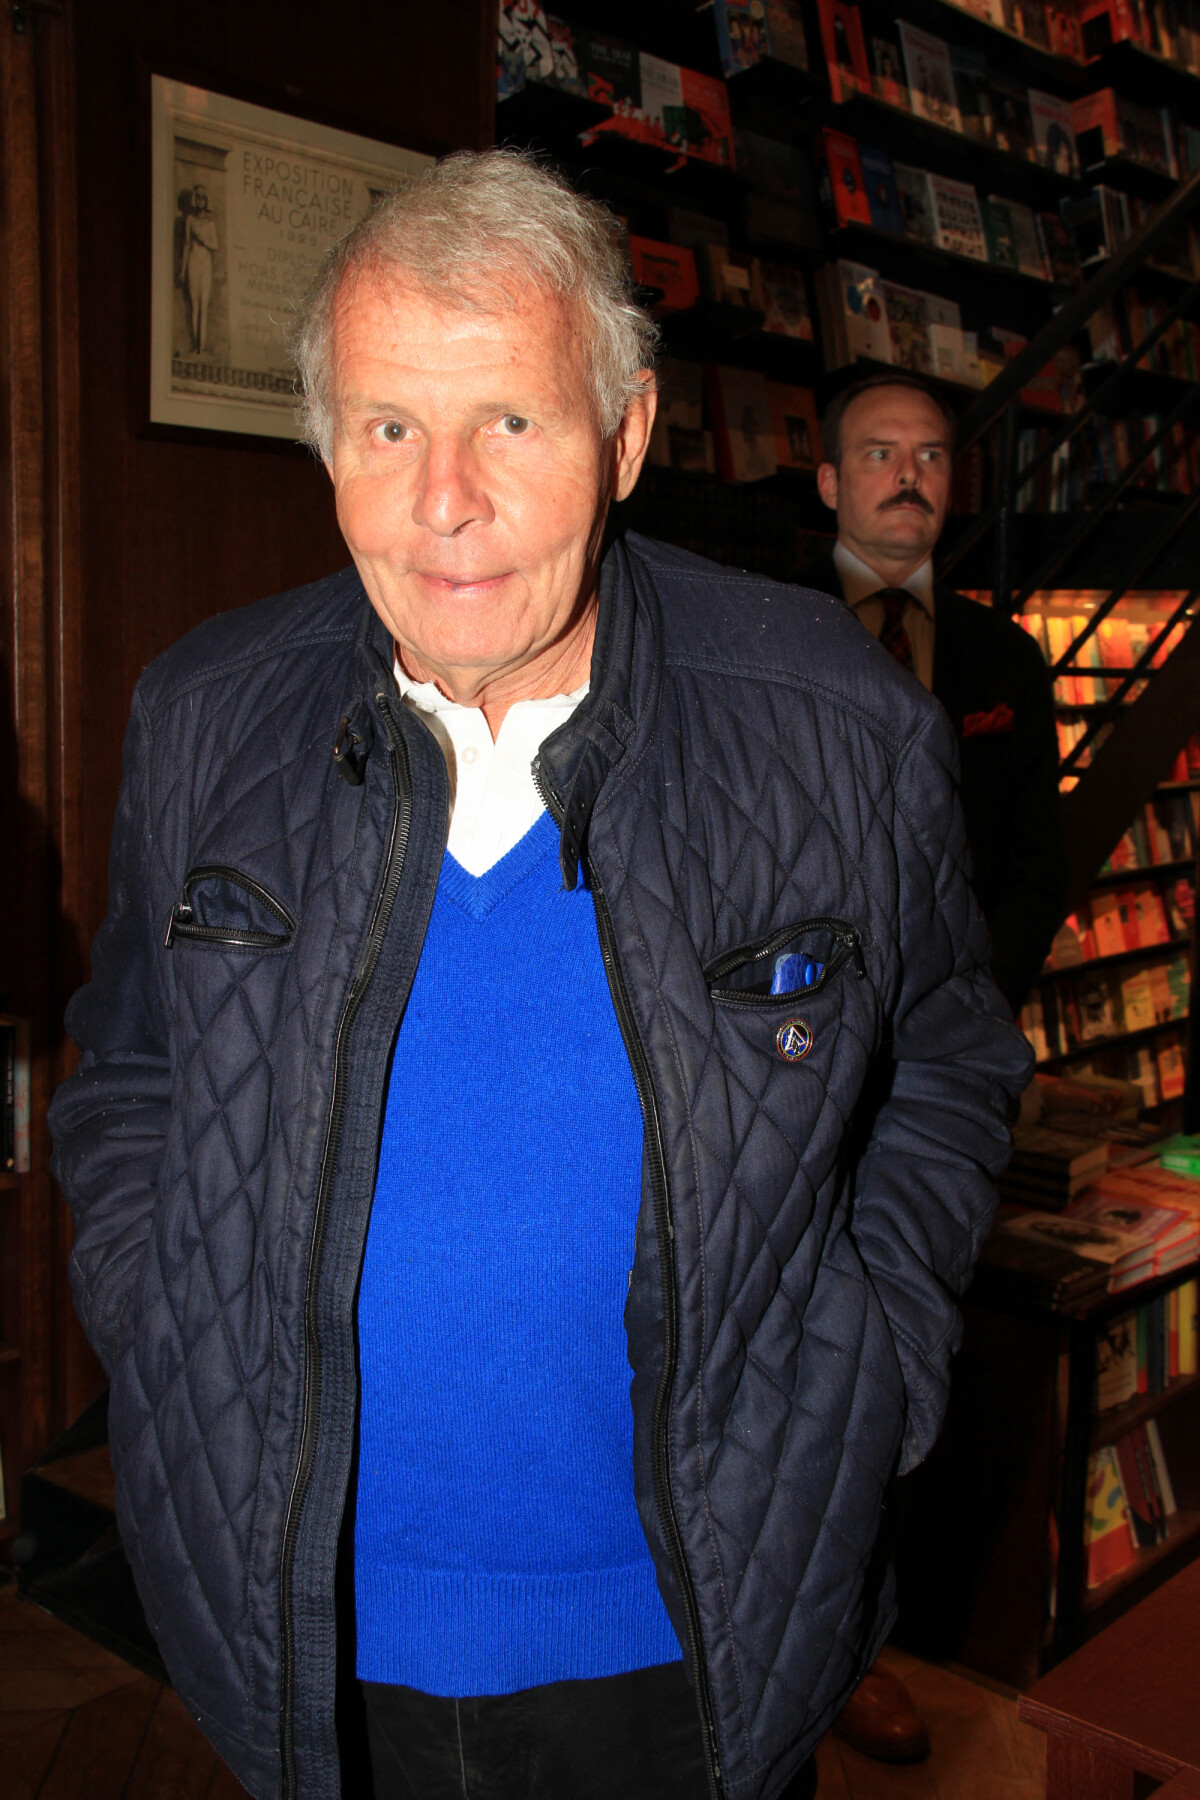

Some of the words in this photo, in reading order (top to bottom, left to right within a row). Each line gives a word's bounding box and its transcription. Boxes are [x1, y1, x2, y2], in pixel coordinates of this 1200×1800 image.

[243, 151, 353, 197] EXPOSITION
[257, 203, 283, 224] AU
[289, 209, 338, 238] CAIRE
[238, 261, 276, 281] HORS
